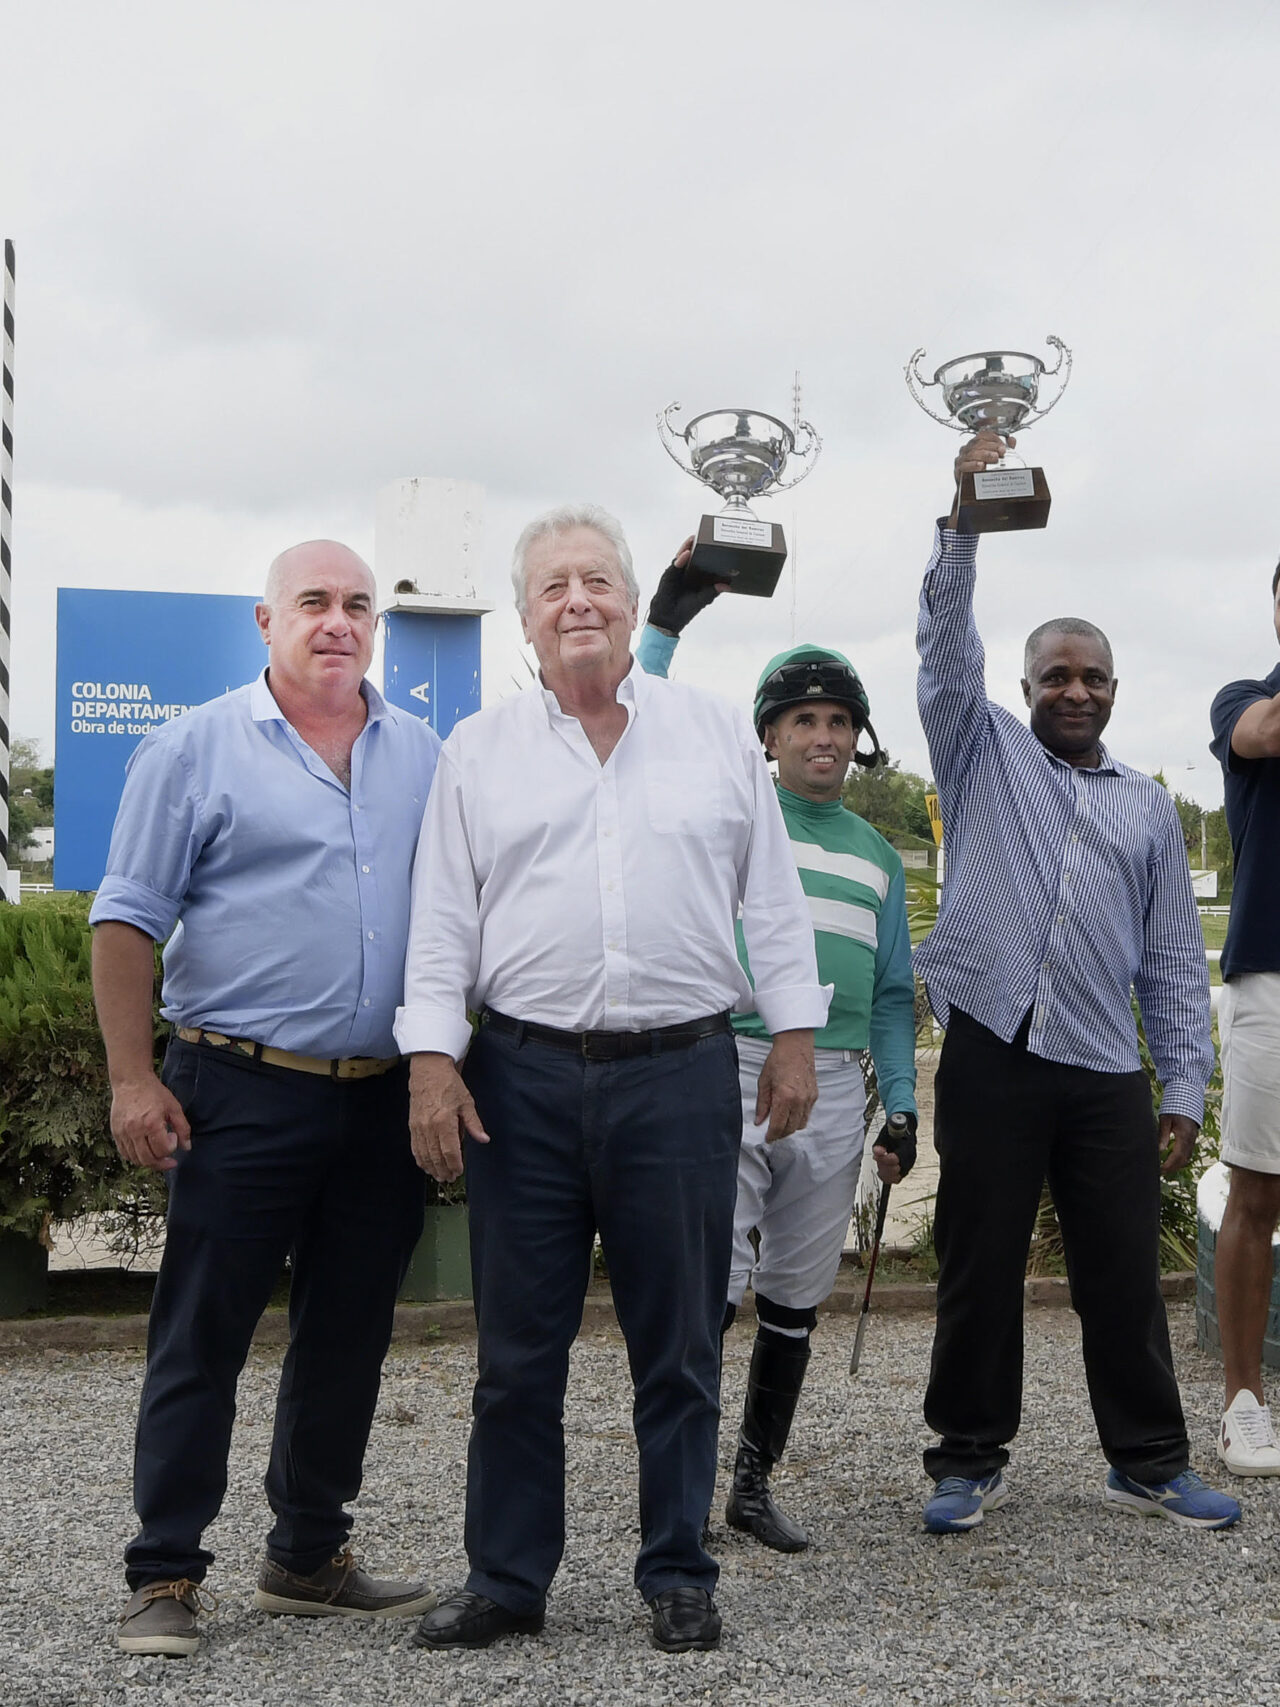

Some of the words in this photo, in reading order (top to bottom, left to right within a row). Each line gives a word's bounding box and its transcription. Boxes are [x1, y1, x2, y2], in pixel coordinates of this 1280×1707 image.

[71, 681, 152, 701] COLONIA
[71, 719, 106, 734] Obra
[107, 721, 125, 735] de
